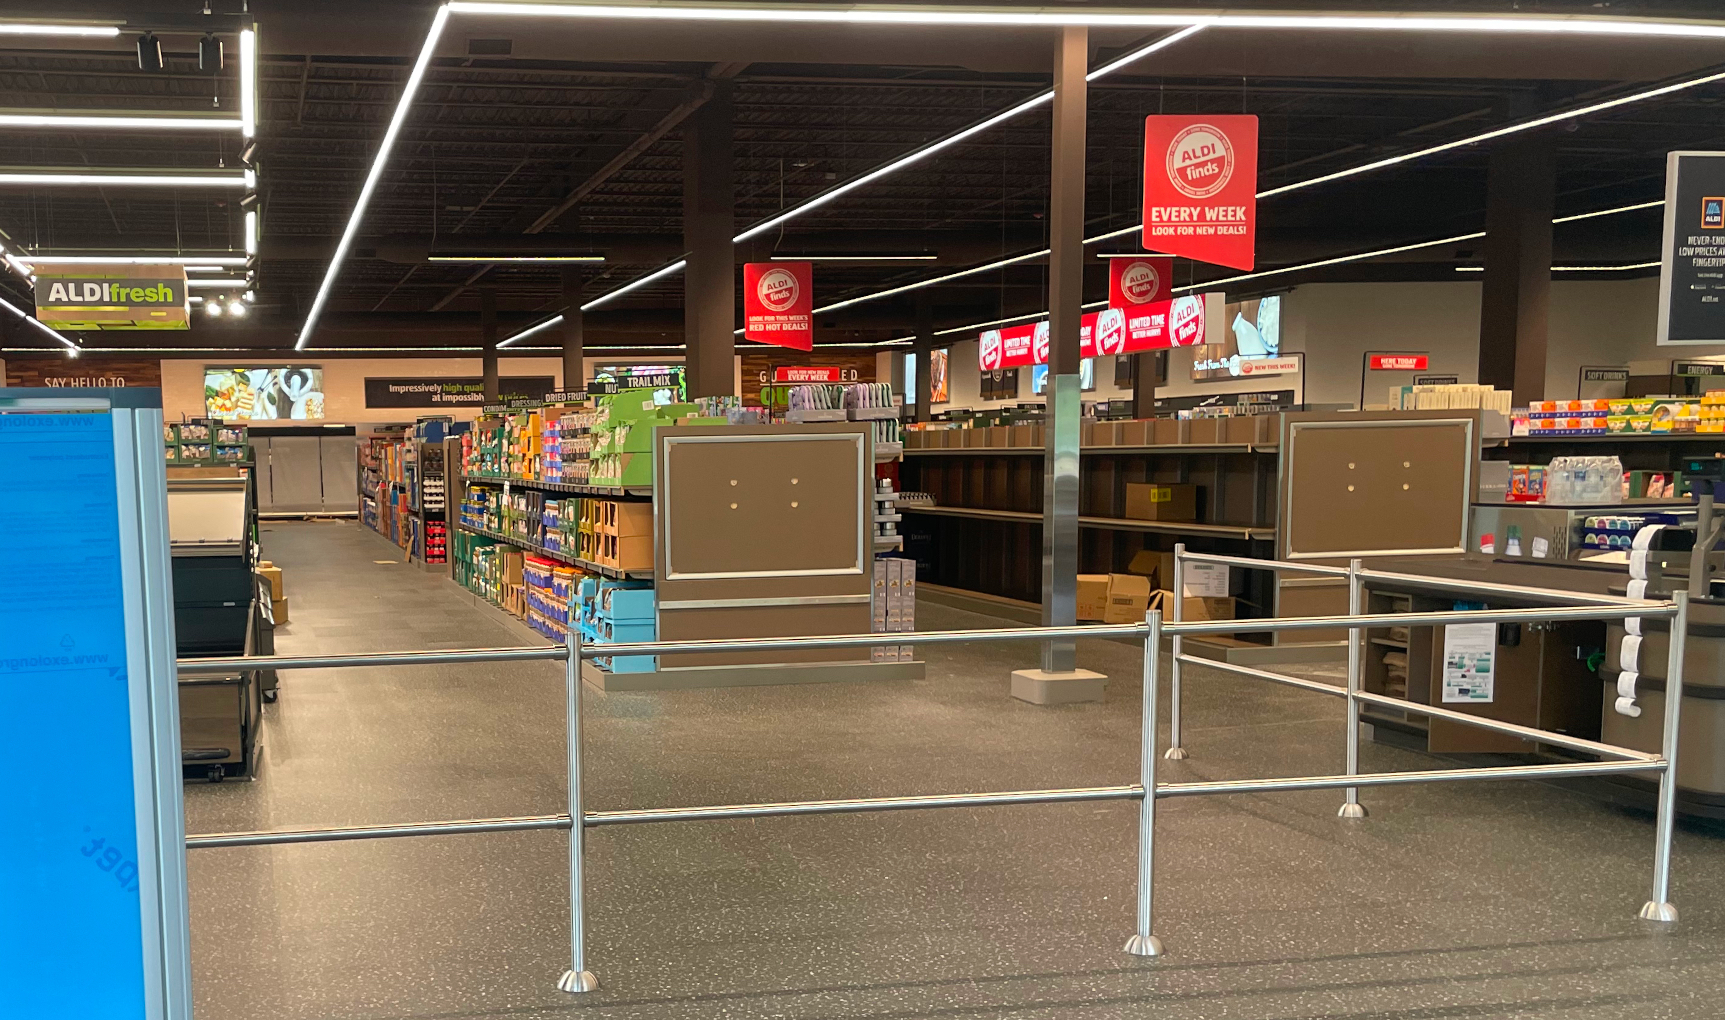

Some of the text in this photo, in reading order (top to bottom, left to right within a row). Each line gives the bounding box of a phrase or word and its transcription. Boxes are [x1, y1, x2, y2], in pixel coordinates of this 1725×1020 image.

[1181, 142, 1217, 163] ALDI
[1186, 161, 1219, 181] finds
[1151, 206, 1247, 222] EVERY WEEK
[1151, 225, 1247, 235] LOOK FOR NEW DEALS!
[1678, 246, 1694, 256] LOW
[1694, 246, 1717, 256] PRICES
[1129, 272, 1149, 284] ALDI
[767, 279, 788, 291] ALDI
[1132, 282, 1151, 294] finds
[48, 282, 173, 303] ALDIfresh
[770, 289, 790, 301] finds
[1151, 313, 1165, 326] TIME
[1176, 303, 1195, 325] ALDI
[749, 322, 808, 332] RED HOT DEALS!
[1102, 315, 1118, 335] ALDI
[1178, 320, 1197, 341] finds
[1020, 335, 1031, 345] TIME
[1103, 331, 1119, 351] finds
[1587, 371, 1627, 380] SOFT DRINKS
[1687, 365, 1713, 375] ENERGY
[44, 377, 125, 388] SAY HELLO TO
[627, 375, 671, 388] TRAIL MIX
[389, 382, 485, 394] Impressively high quali
[431, 393, 441, 402] at
[545, 391, 587, 402] DRIED FRUIT
